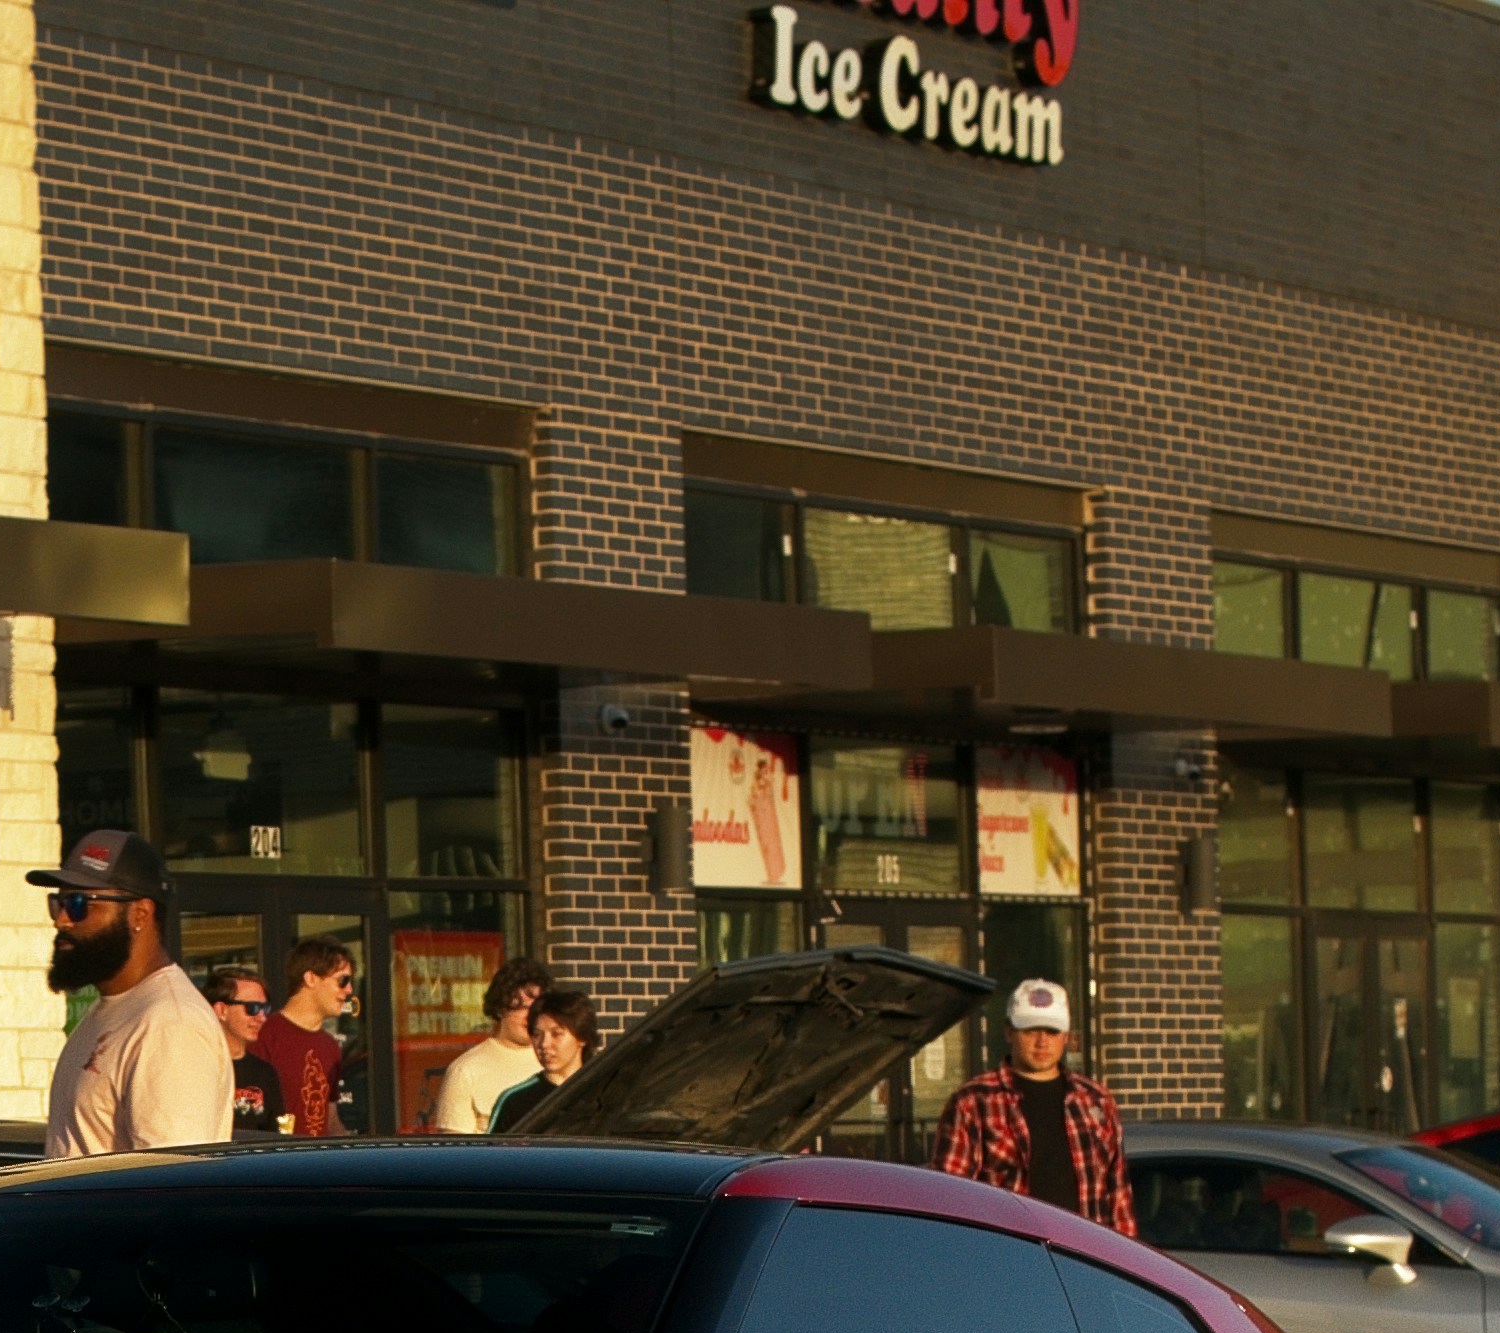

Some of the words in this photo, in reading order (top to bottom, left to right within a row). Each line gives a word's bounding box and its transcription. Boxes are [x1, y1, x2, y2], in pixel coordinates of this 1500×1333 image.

[770, 5, 862, 119] Ice
[879, 35, 1064, 165] Cream
[251, 827, 281, 858] 204
